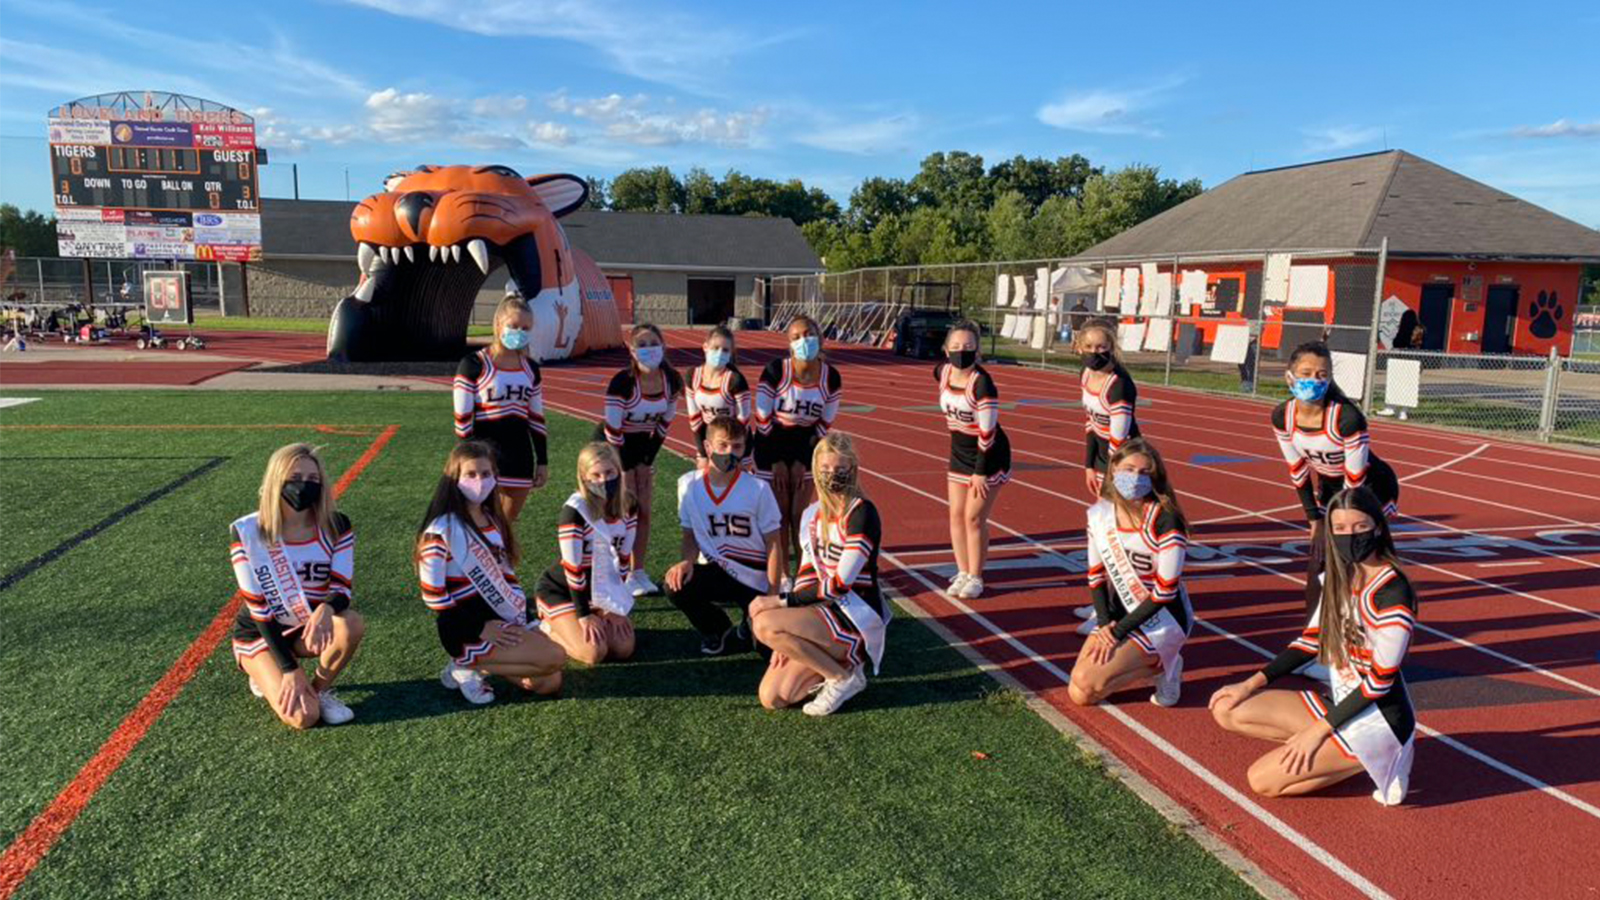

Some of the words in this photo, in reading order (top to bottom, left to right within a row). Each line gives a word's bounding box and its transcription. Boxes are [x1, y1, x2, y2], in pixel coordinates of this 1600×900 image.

[53, 145, 97, 158] TIGERS
[213, 150, 251, 163] GUEST
[84, 178, 111, 189] DOWN
[121, 179, 133, 190] TO
[134, 179, 147, 190] GO
[161, 180, 181, 191] BALL
[181, 181, 194, 191] ON
[204, 181, 222, 192] QTR
[777, 398, 823, 418] LHS
[708, 513, 751, 538] HS
[469, 540, 500, 582] VARSITY
[1106, 528, 1130, 575] VARSITY
[468, 565, 506, 608] HARPER
[1102, 548, 1135, 606] FLANAGAN
[254, 564, 290, 619] SOUPENE
